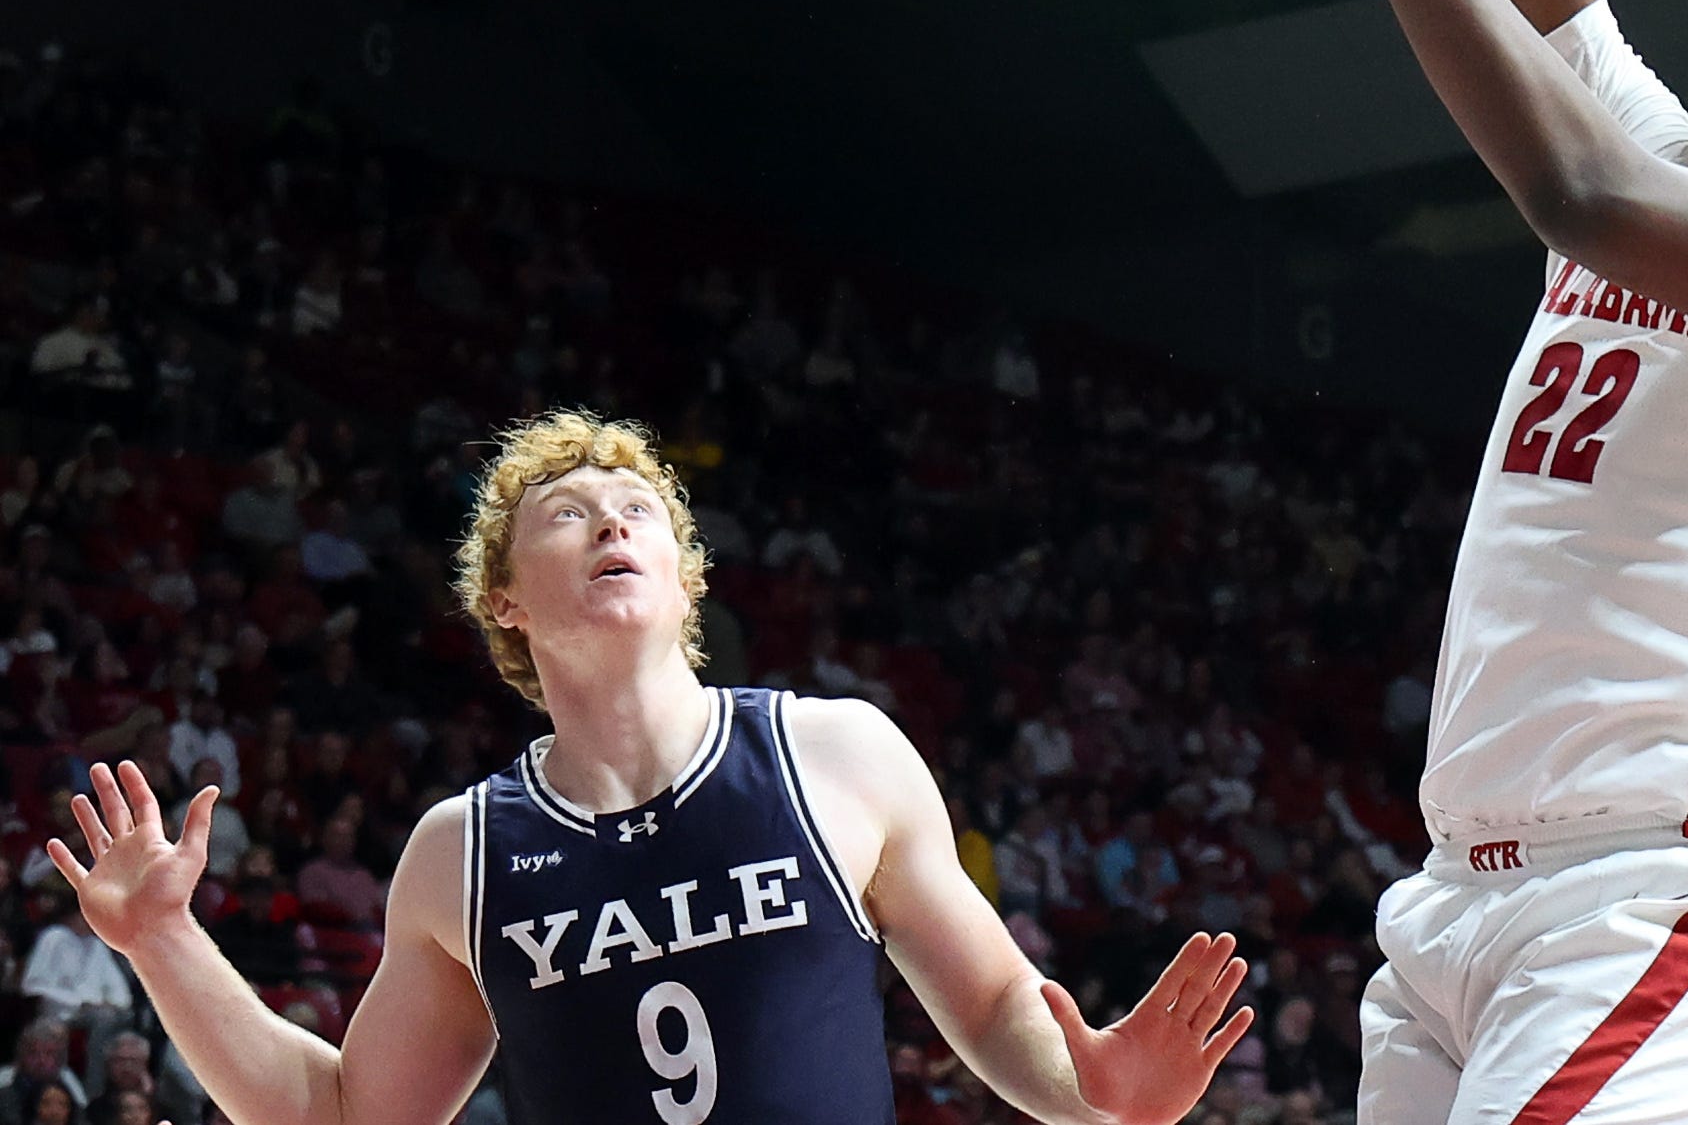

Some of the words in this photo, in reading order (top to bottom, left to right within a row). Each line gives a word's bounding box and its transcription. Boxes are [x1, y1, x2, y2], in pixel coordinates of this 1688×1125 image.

[1501, 341, 1641, 484] 22
[501, 856, 808, 990] YALE
[511, 854, 545, 873] Ivy
[1469, 840, 1523, 872] RTR
[636, 981, 718, 1125] 9
